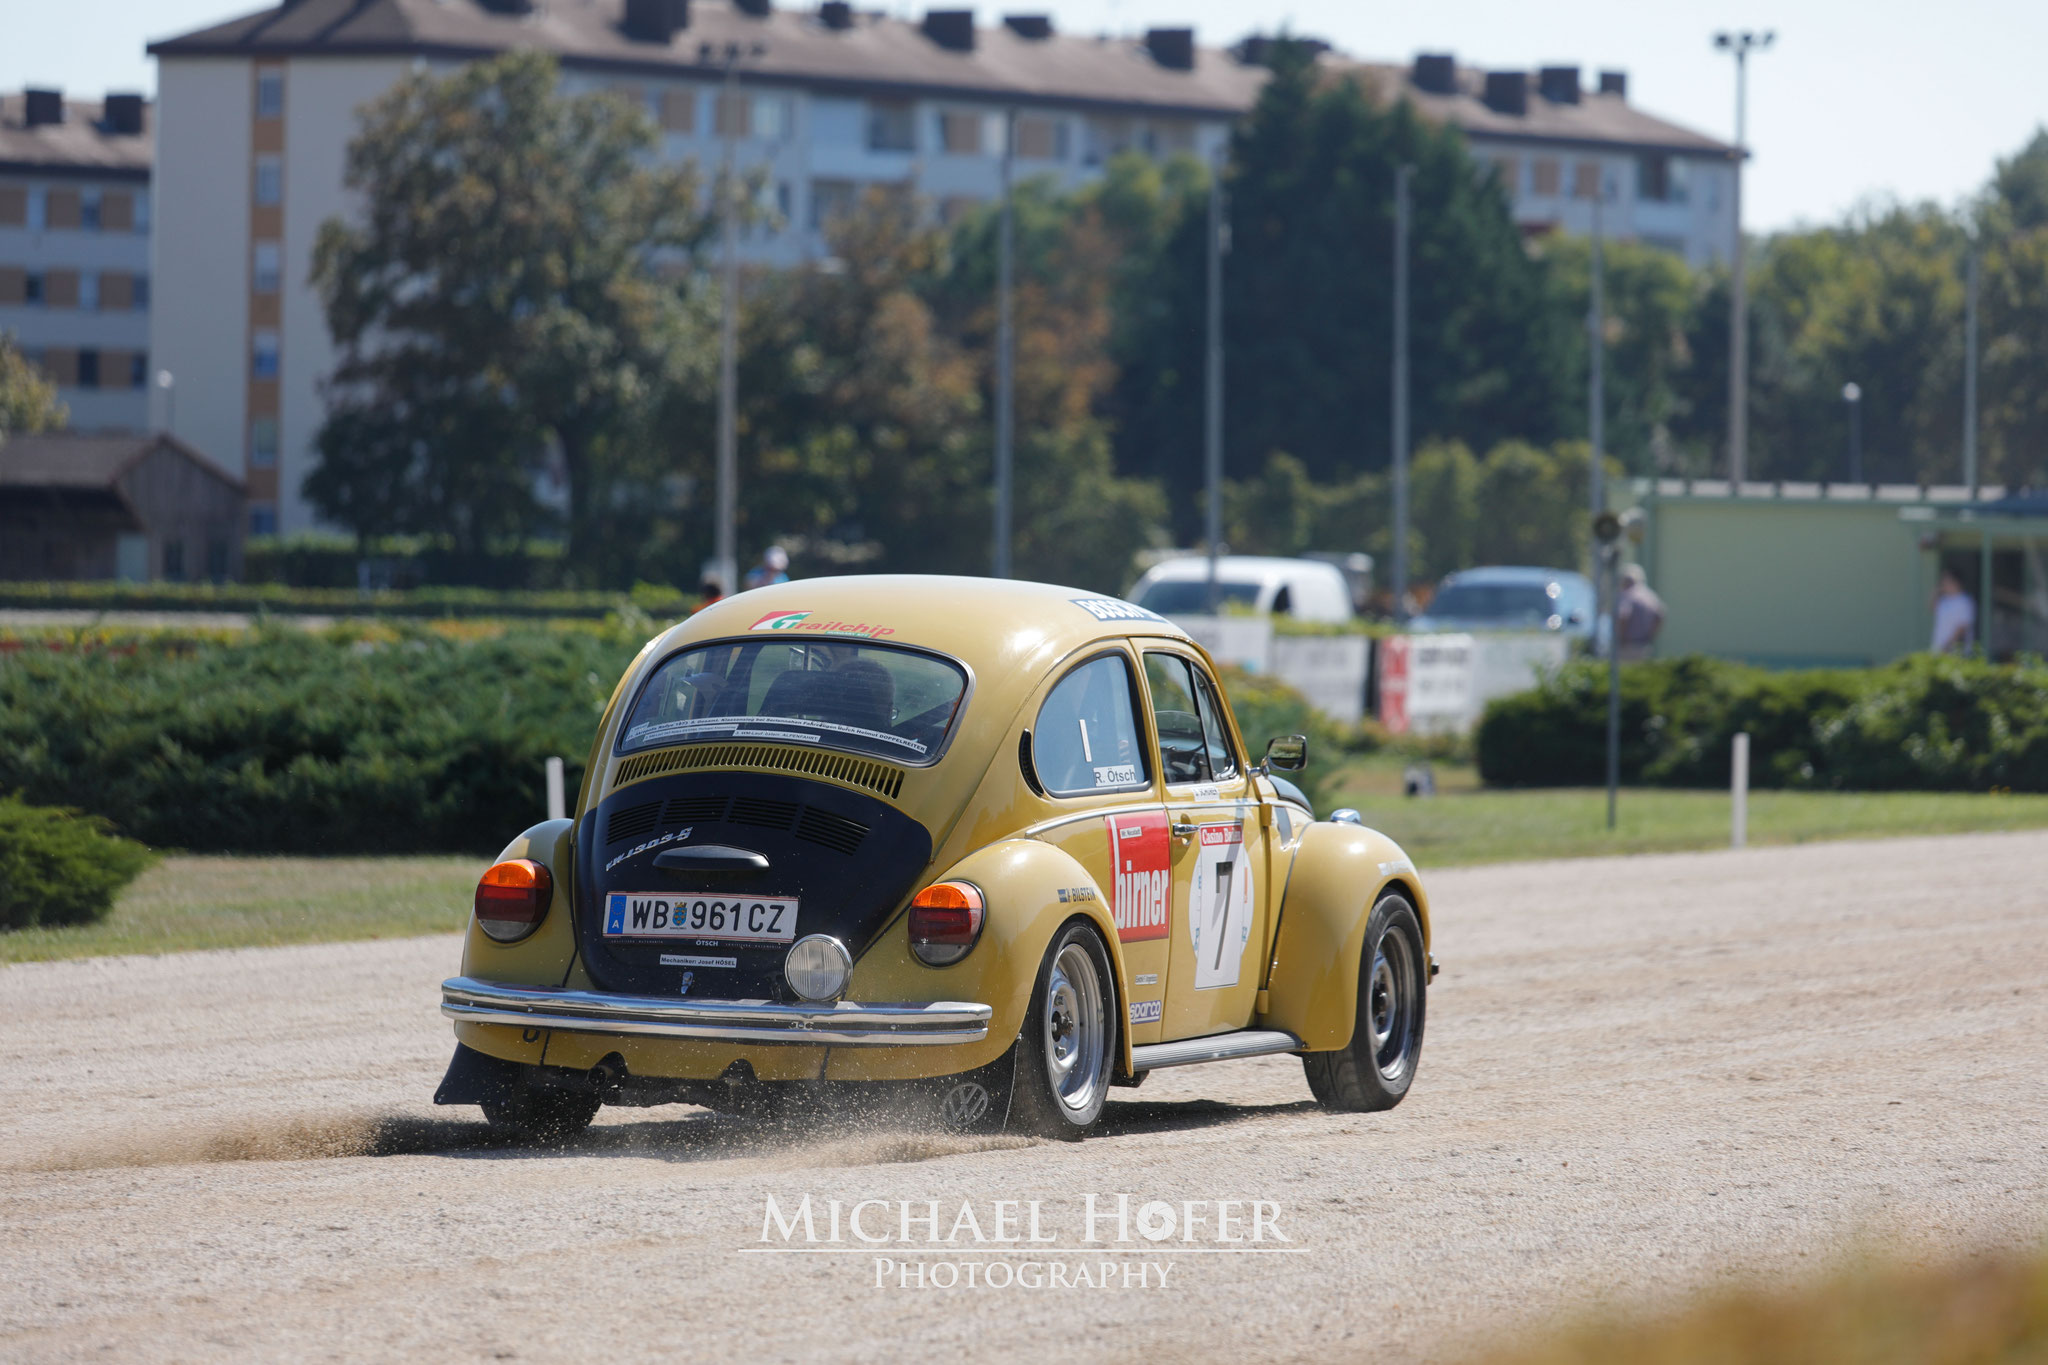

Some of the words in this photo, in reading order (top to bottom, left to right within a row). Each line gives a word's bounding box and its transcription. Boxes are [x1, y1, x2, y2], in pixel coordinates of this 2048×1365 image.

[780, 619, 896, 638] Trailchip
[1095, 771, 1106, 784] R.
[1107, 767, 1136, 783] Ötsch
[1203, 829, 1223, 845] Casino
[1115, 860, 1170, 929] birner
[612, 919, 620, 929] A
[632, 900, 669, 930] WB
[1214, 861, 1233, 971] 7
[661, 957, 697, 965] Mechaniker:
[715, 958, 736, 966] HÖSEL
[1130, 1001, 1160, 1021] sparco
